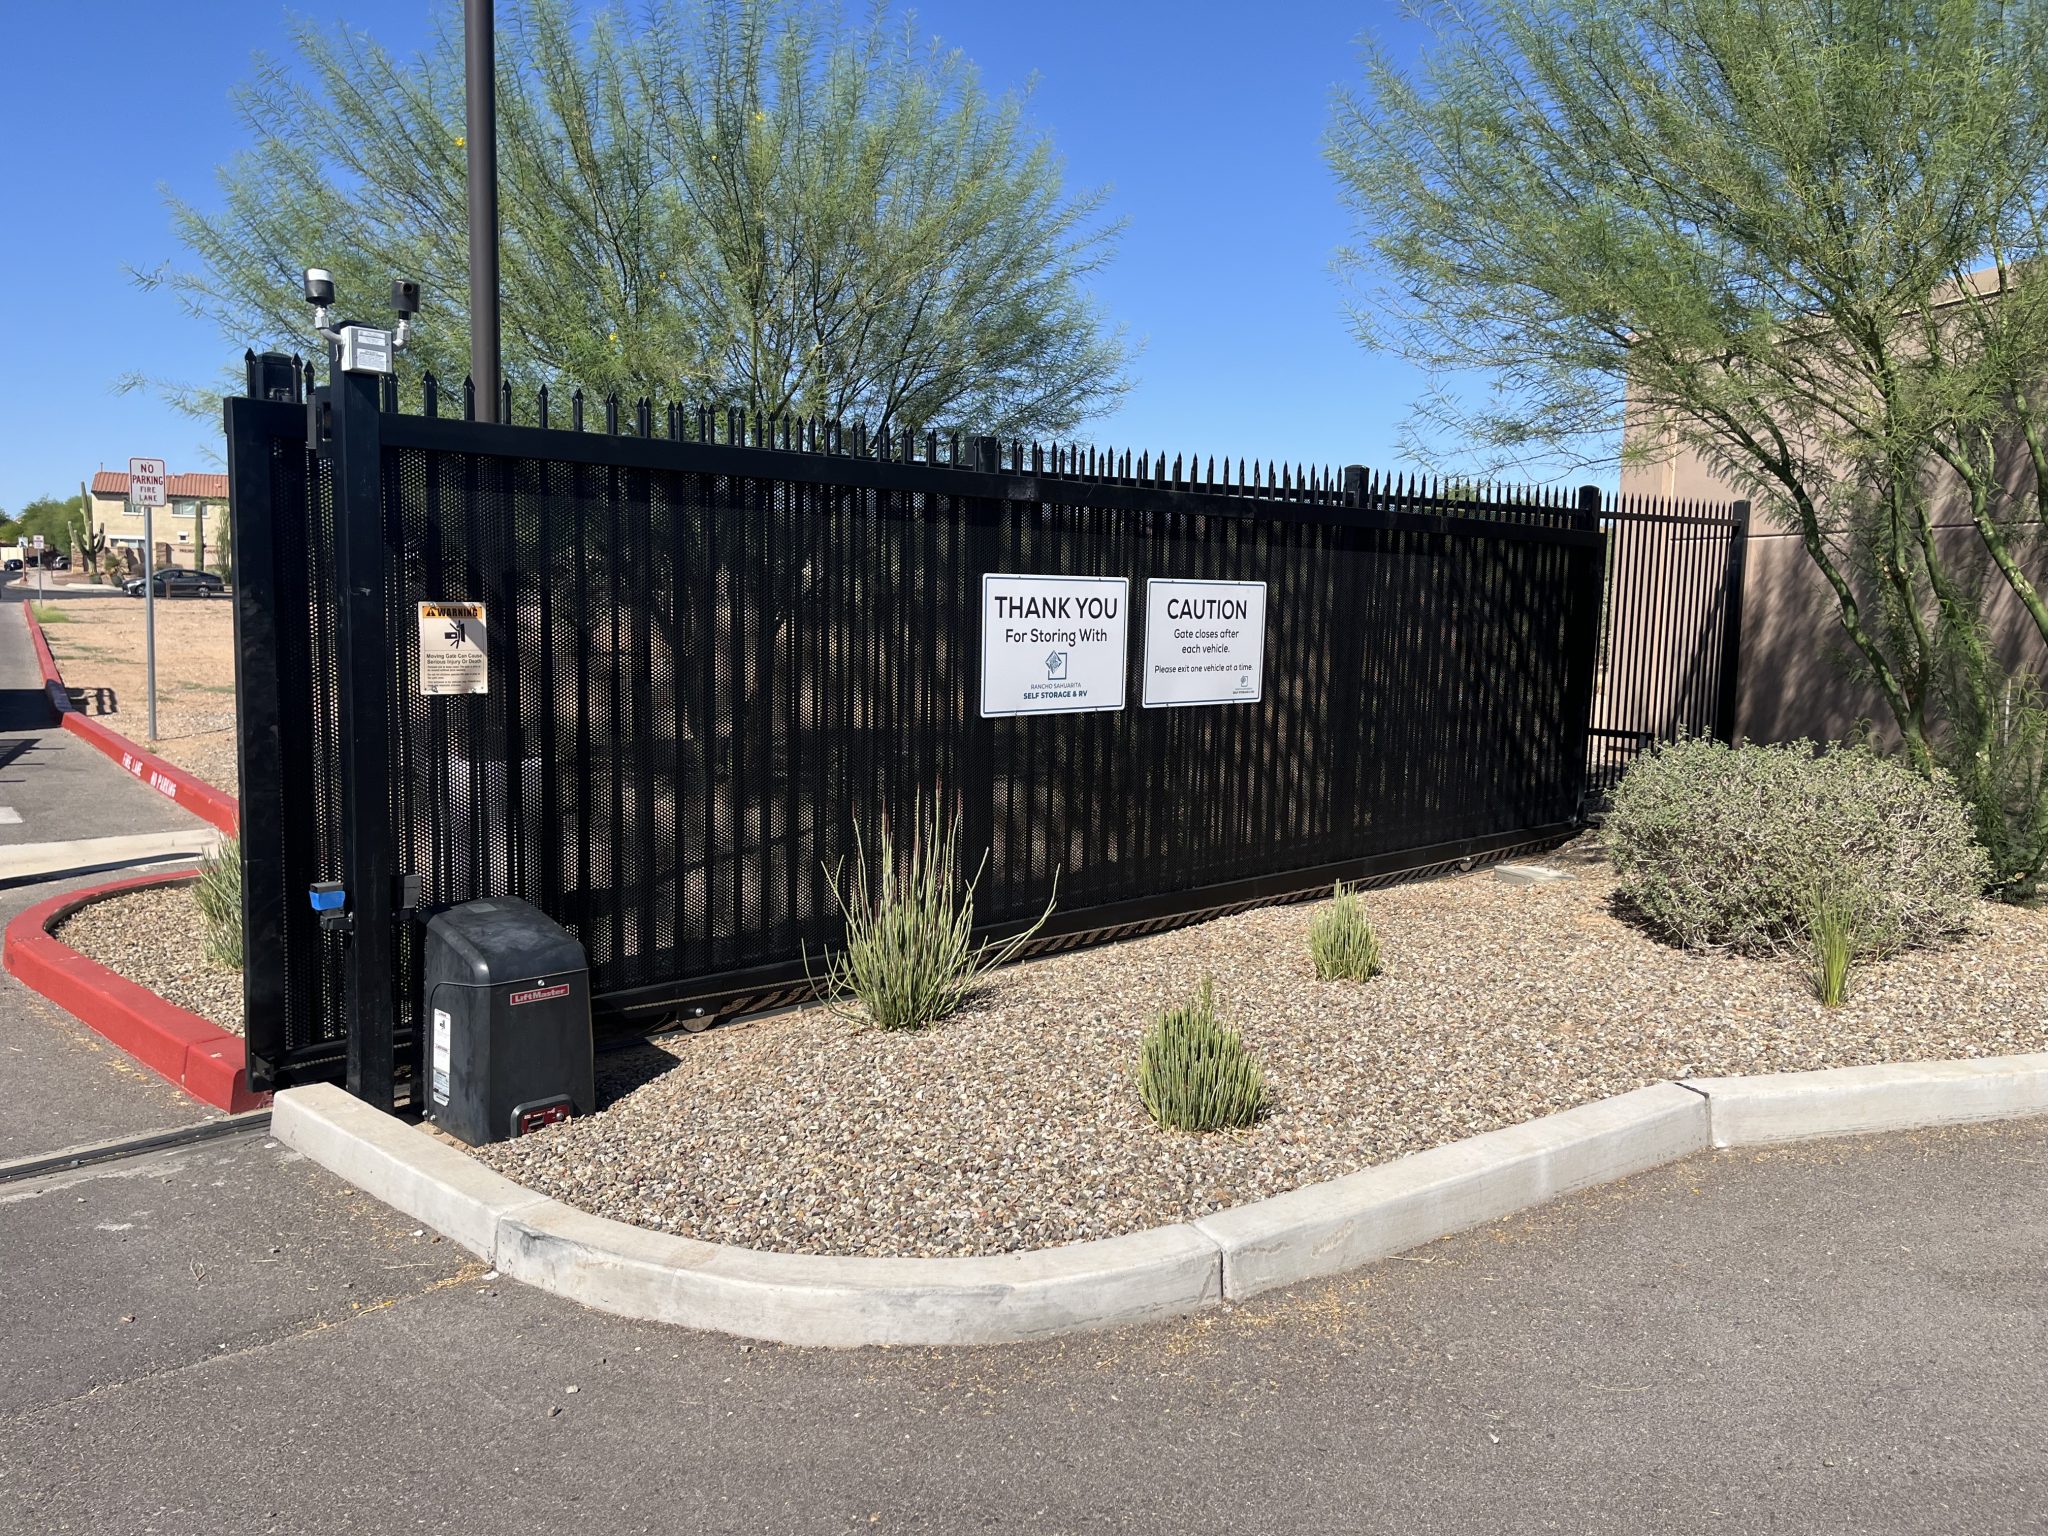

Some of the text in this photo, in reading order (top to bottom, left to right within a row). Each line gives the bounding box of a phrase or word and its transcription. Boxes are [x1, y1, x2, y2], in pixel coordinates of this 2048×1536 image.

[141, 464, 154, 473] NO
[132, 475, 163, 485] PARKING
[437, 607, 478, 617] WARNING
[995, 596, 1118, 619] THANK YOU
[1167, 598, 1247, 620] CAUTION
[1005, 628, 1107, 647] For Storing With
[1174, 629, 1239, 639] Gate closes after
[1181, 643, 1230, 654] each vehicle.
[1154, 665, 1176, 673] Please
[1203, 664, 1224, 672] vehicle
[1239, 663, 1253, 671] time.
[122, 752, 143, 777] FIRE LANE
[150, 770, 177, 798] NO PARKING
[515, 989, 566, 1002] LiftMaster
